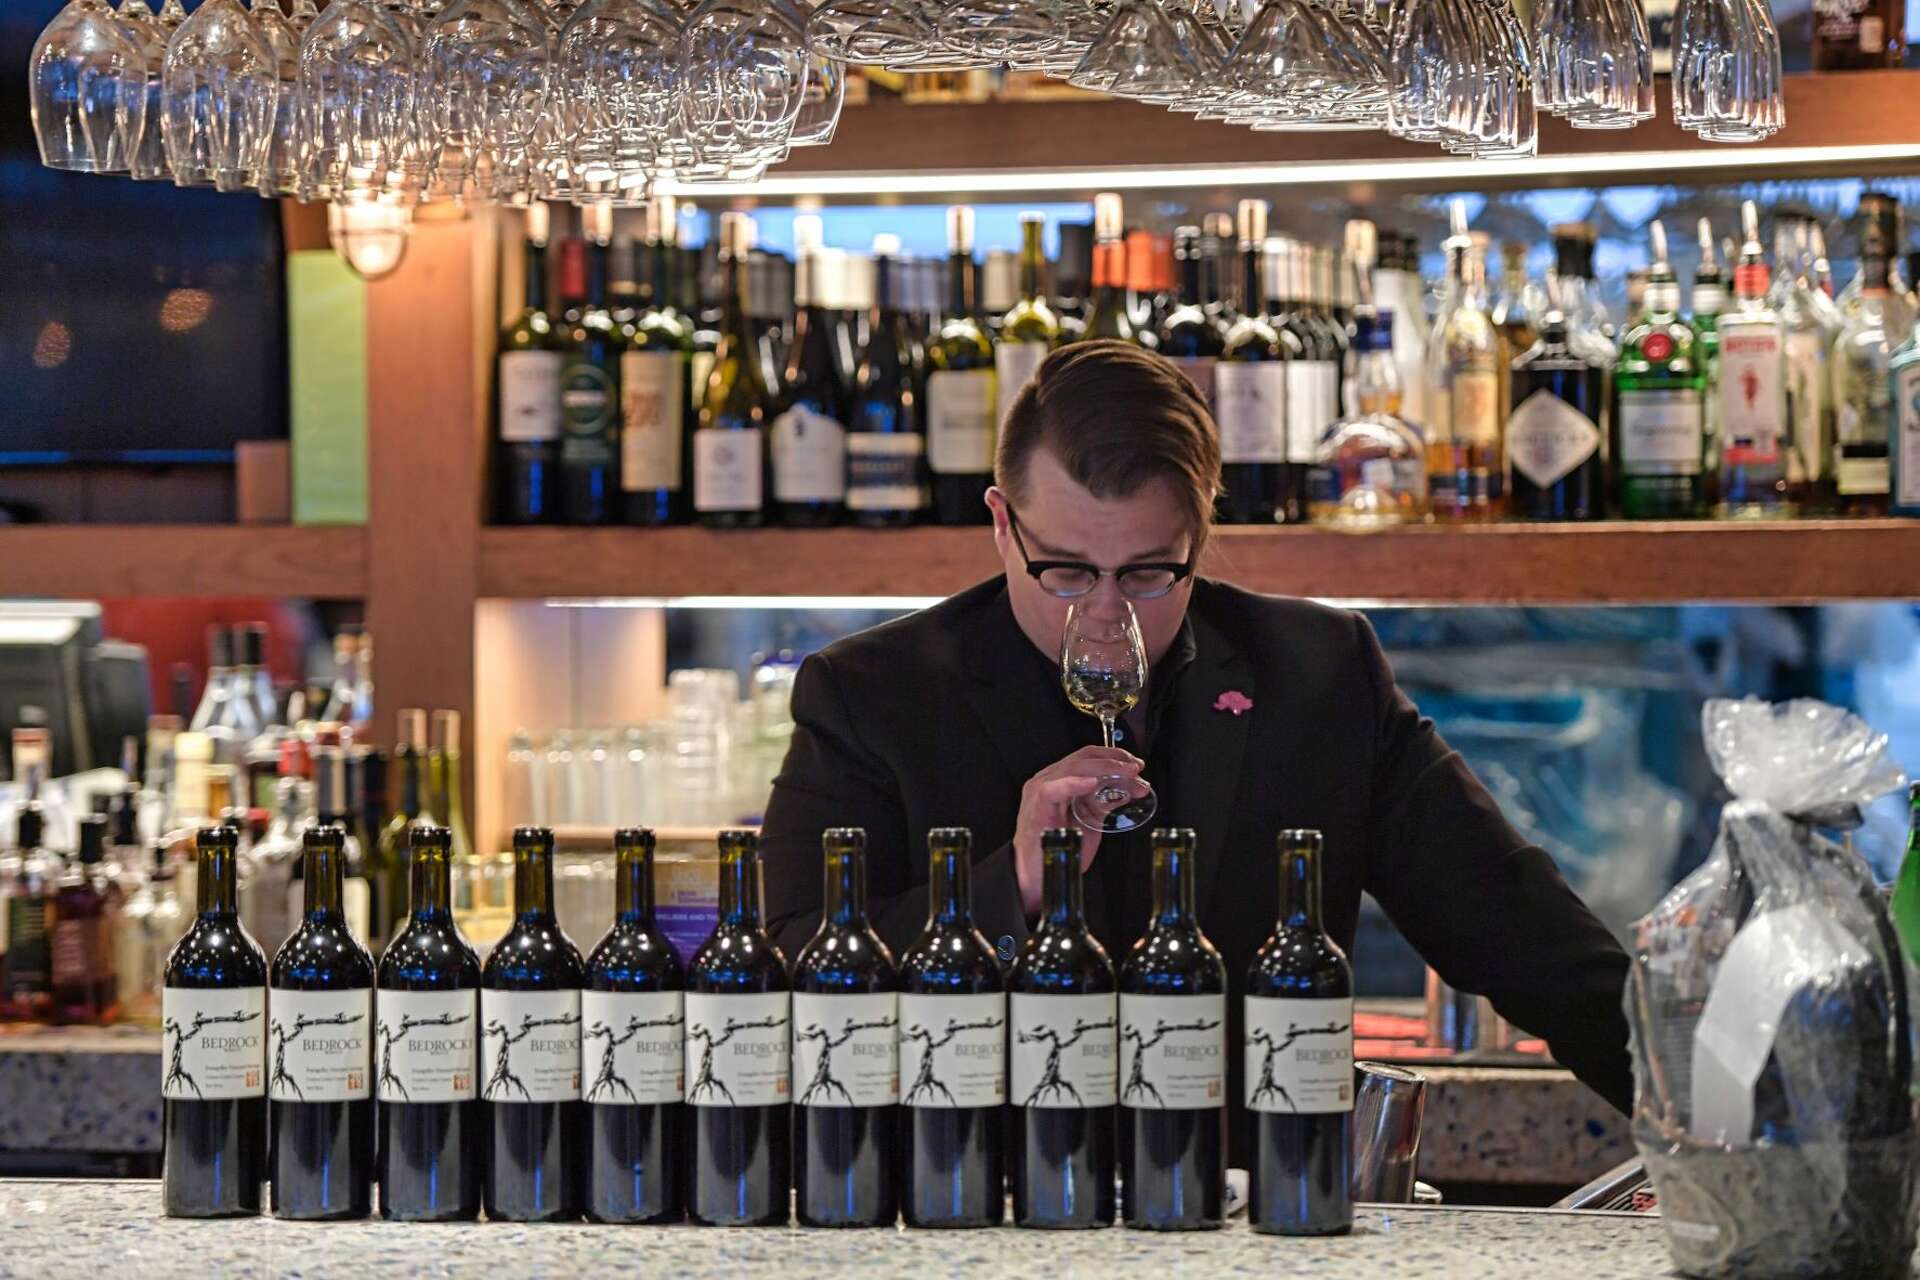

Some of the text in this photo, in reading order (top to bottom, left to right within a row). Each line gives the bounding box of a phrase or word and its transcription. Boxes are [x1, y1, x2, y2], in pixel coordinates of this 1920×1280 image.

[201, 1036, 258, 1049] BEDROCK
[303, 1038, 362, 1051] BEDROCK
[408, 1038, 469, 1052] BEDROCK
[531, 1039, 581, 1052] BEDROC
